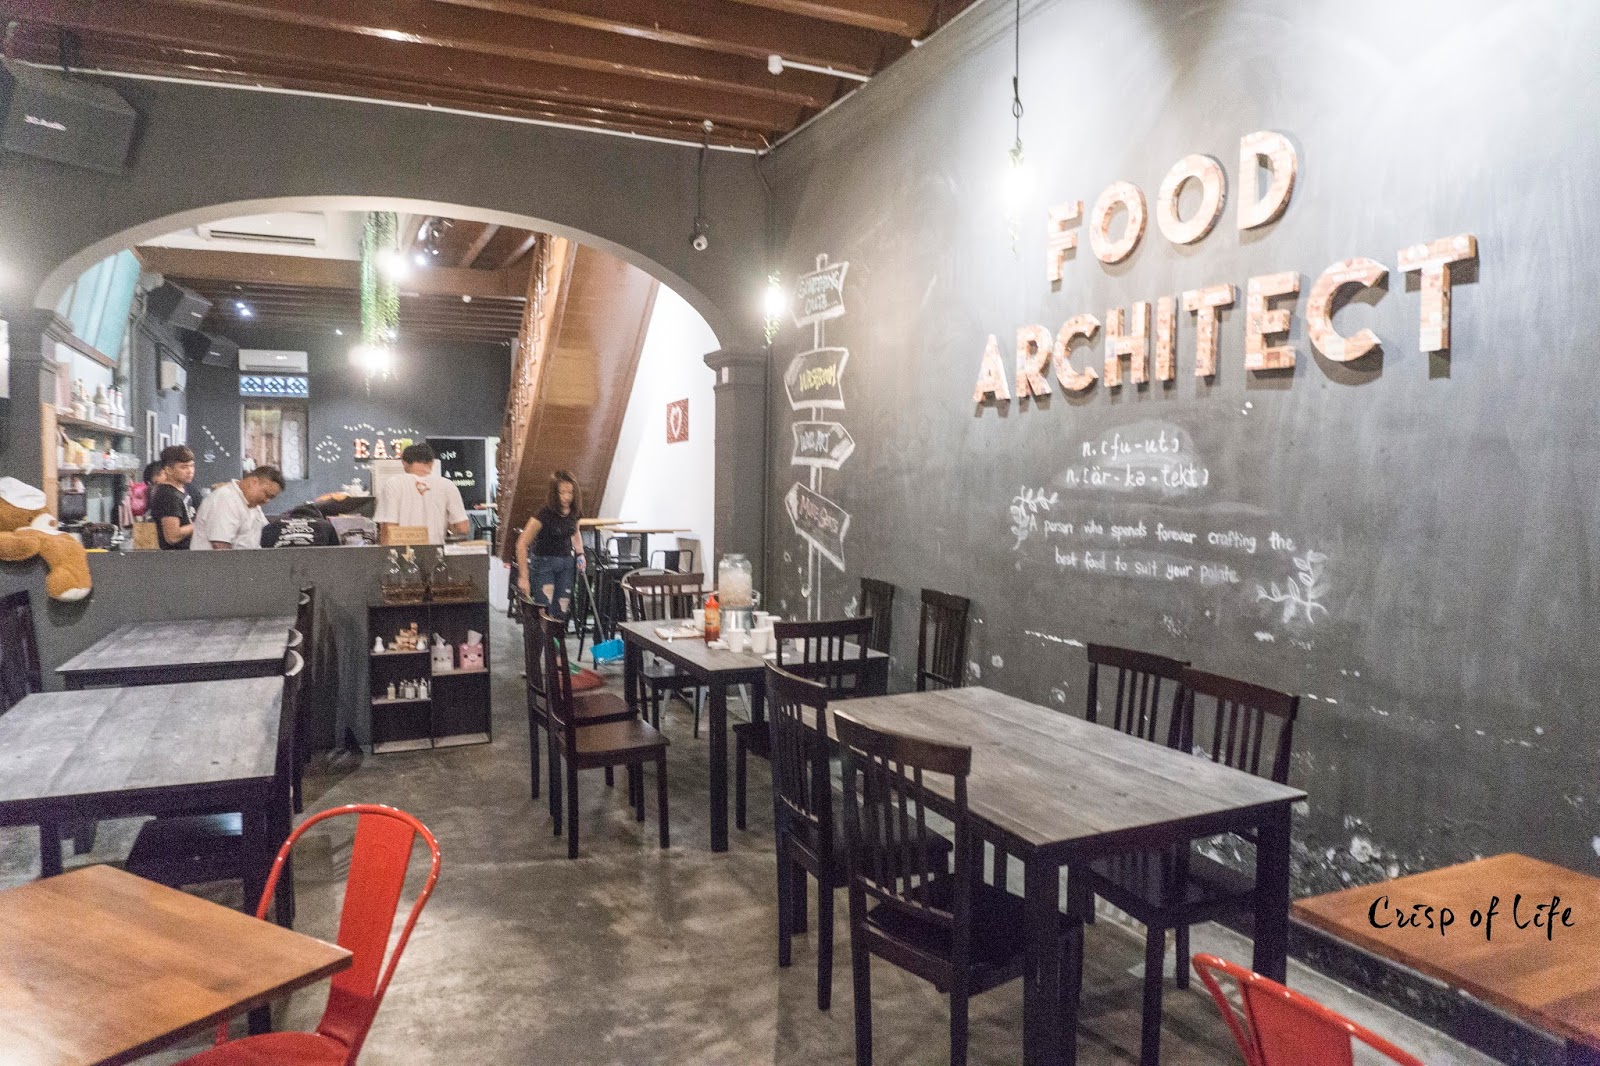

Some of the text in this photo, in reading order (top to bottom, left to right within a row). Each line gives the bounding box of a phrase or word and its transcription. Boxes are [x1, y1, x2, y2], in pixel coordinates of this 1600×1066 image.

[1047, 130, 1299, 283] FOOD
[973, 233, 1478, 404] ARCHITECT
[353, 438, 403, 459] EAT
[1082, 441, 1097, 458] n.
[1065, 468, 1081, 485] n.
[1044, 518, 1074, 539] person
[1083, 517, 1104, 536] who
[1110, 518, 1148, 543] spends
[1154, 521, 1198, 545] forever
[1207, 530, 1258, 555] crafting
[1268, 530, 1297, 552] the
[1054, 545, 1078, 567] best
[1083, 550, 1107, 573] food
[1114, 556, 1128, 573] to
[1134, 559, 1159, 578] suit
[1165, 563, 1195, 582] your
